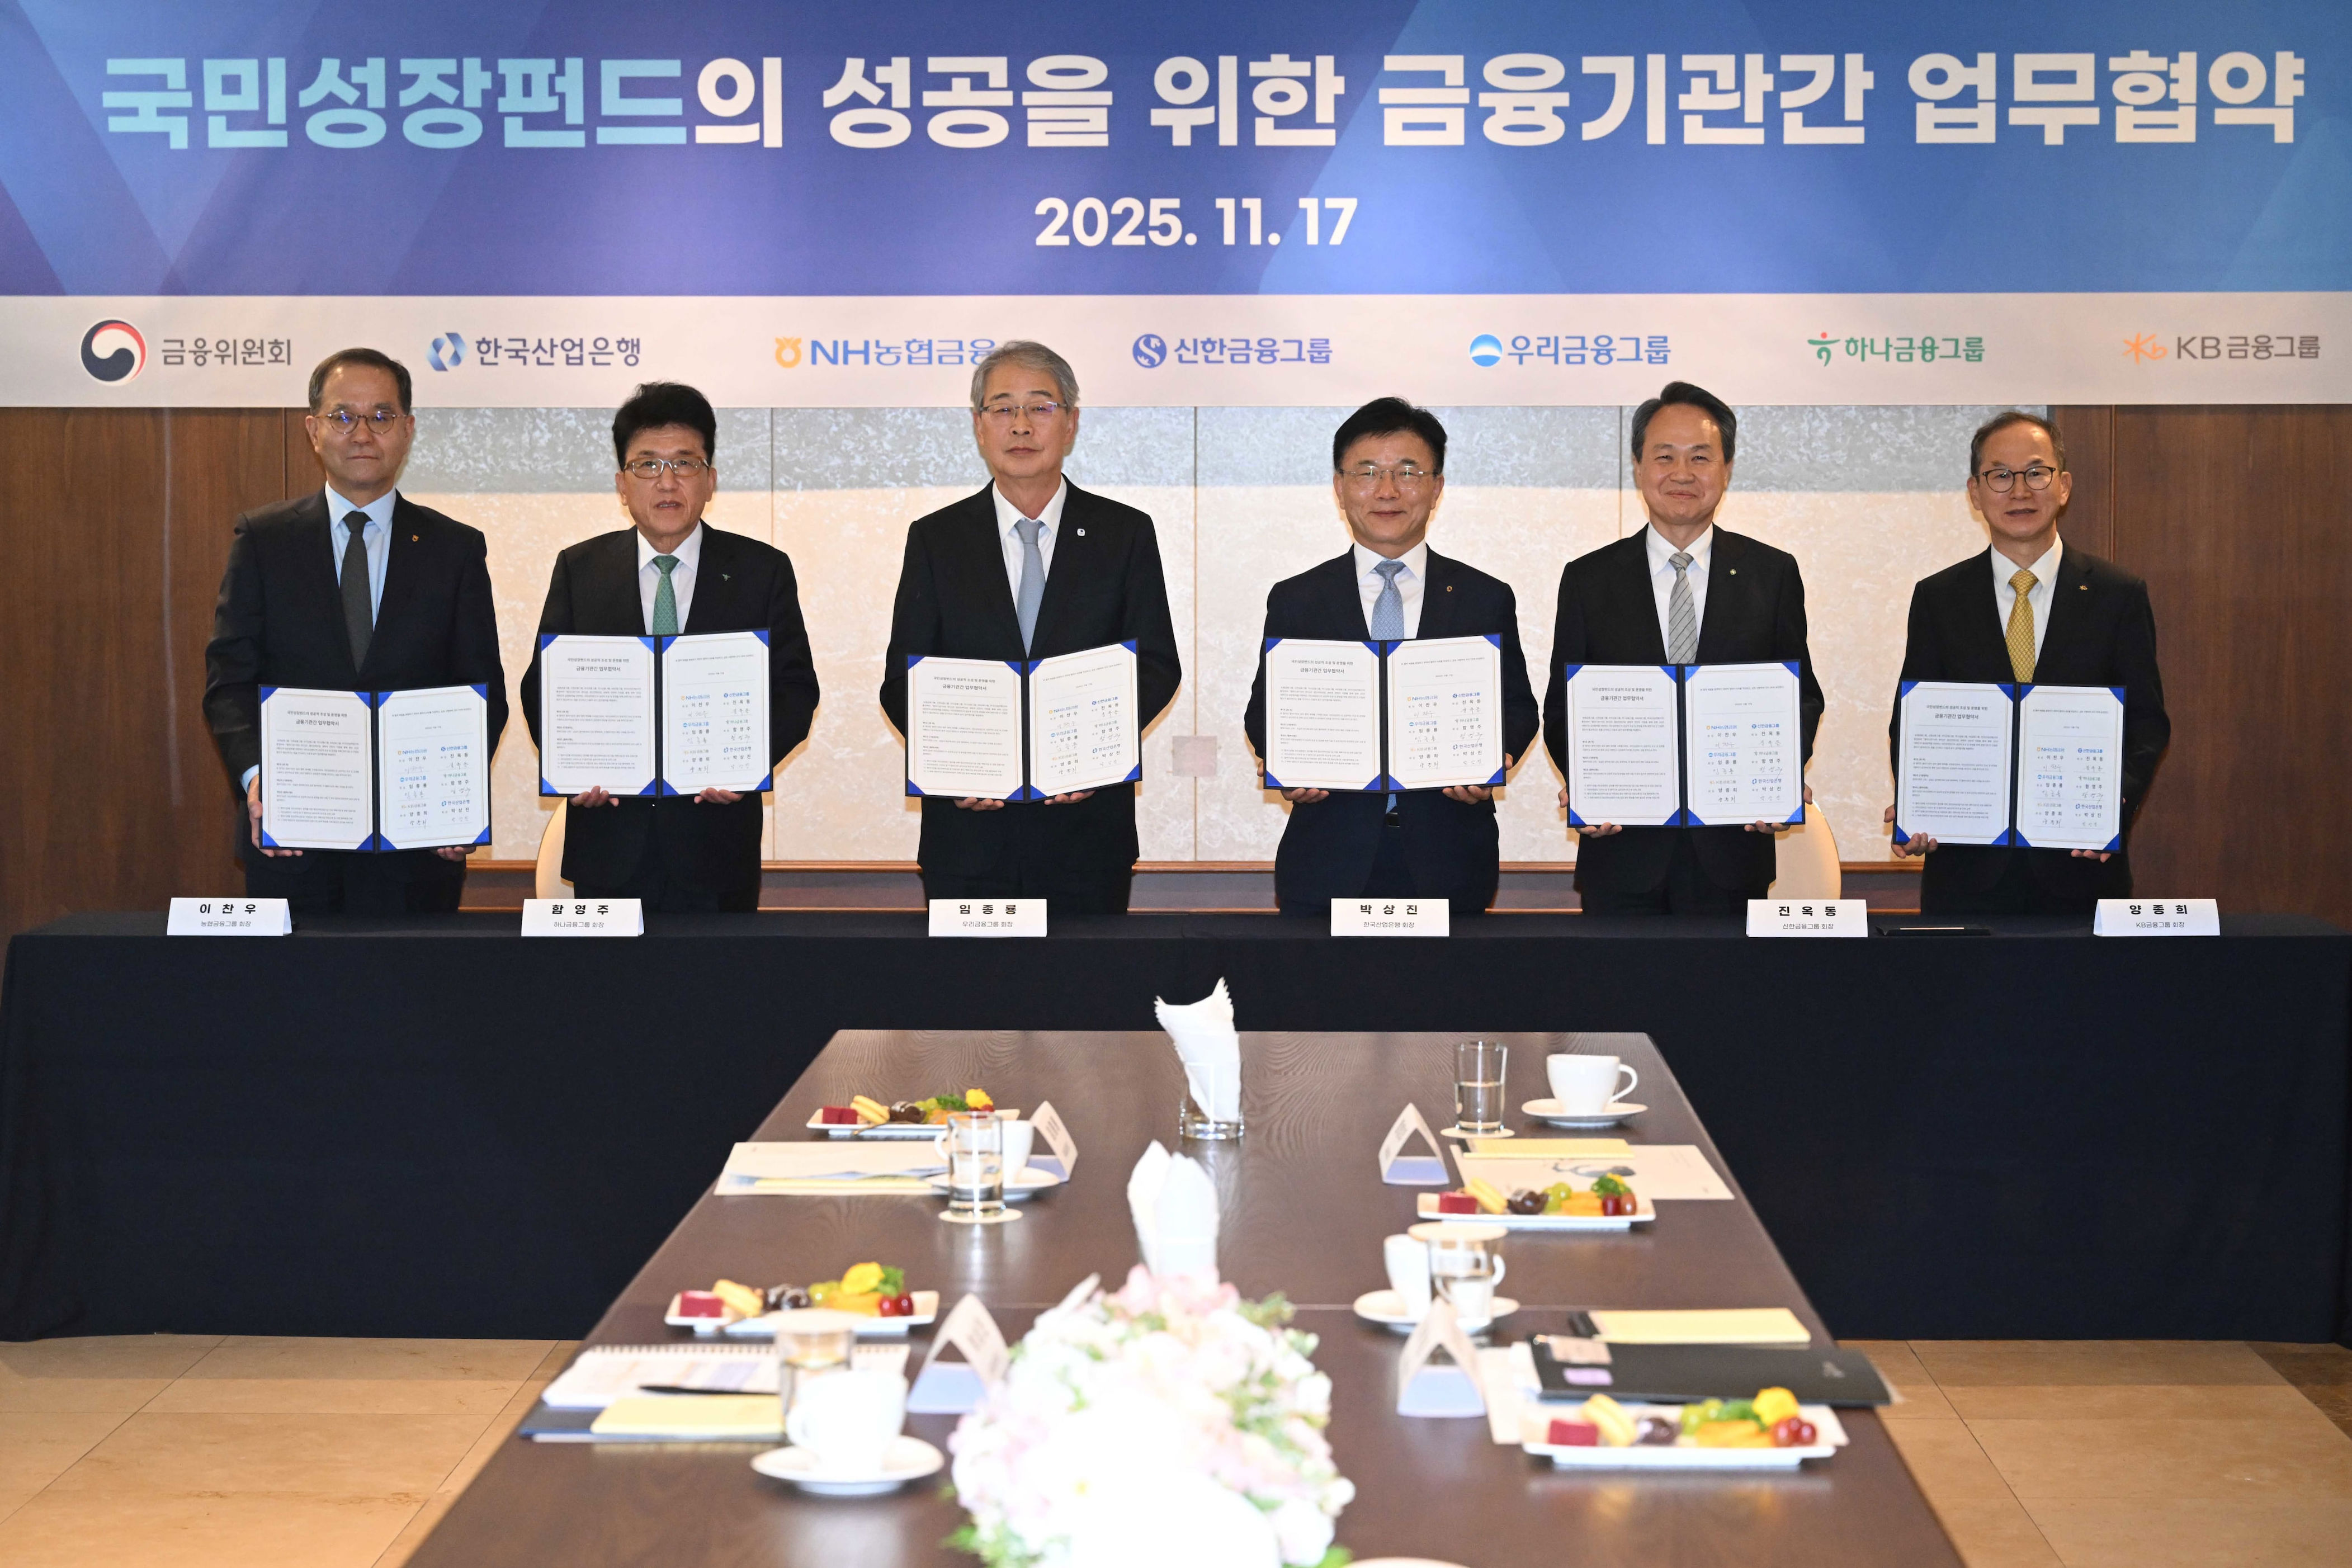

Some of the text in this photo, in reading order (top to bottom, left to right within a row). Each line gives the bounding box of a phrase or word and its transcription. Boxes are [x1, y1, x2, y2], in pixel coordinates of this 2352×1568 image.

[102, 51, 2305, 149] 국민성장펀드의 성공을 위한 금융기관간 업무협약
[1035, 197, 1358, 247] 2025. 11. 17
[162, 338, 291, 367] 금융위원회
[475, 337, 640, 367] 한국산업은행
[1174, 337, 1333, 365] 신한금융그룹
[1508, 334, 1671, 366] 우리금융그룹
[1845, 336, 1985, 363] 하나금융그룹
